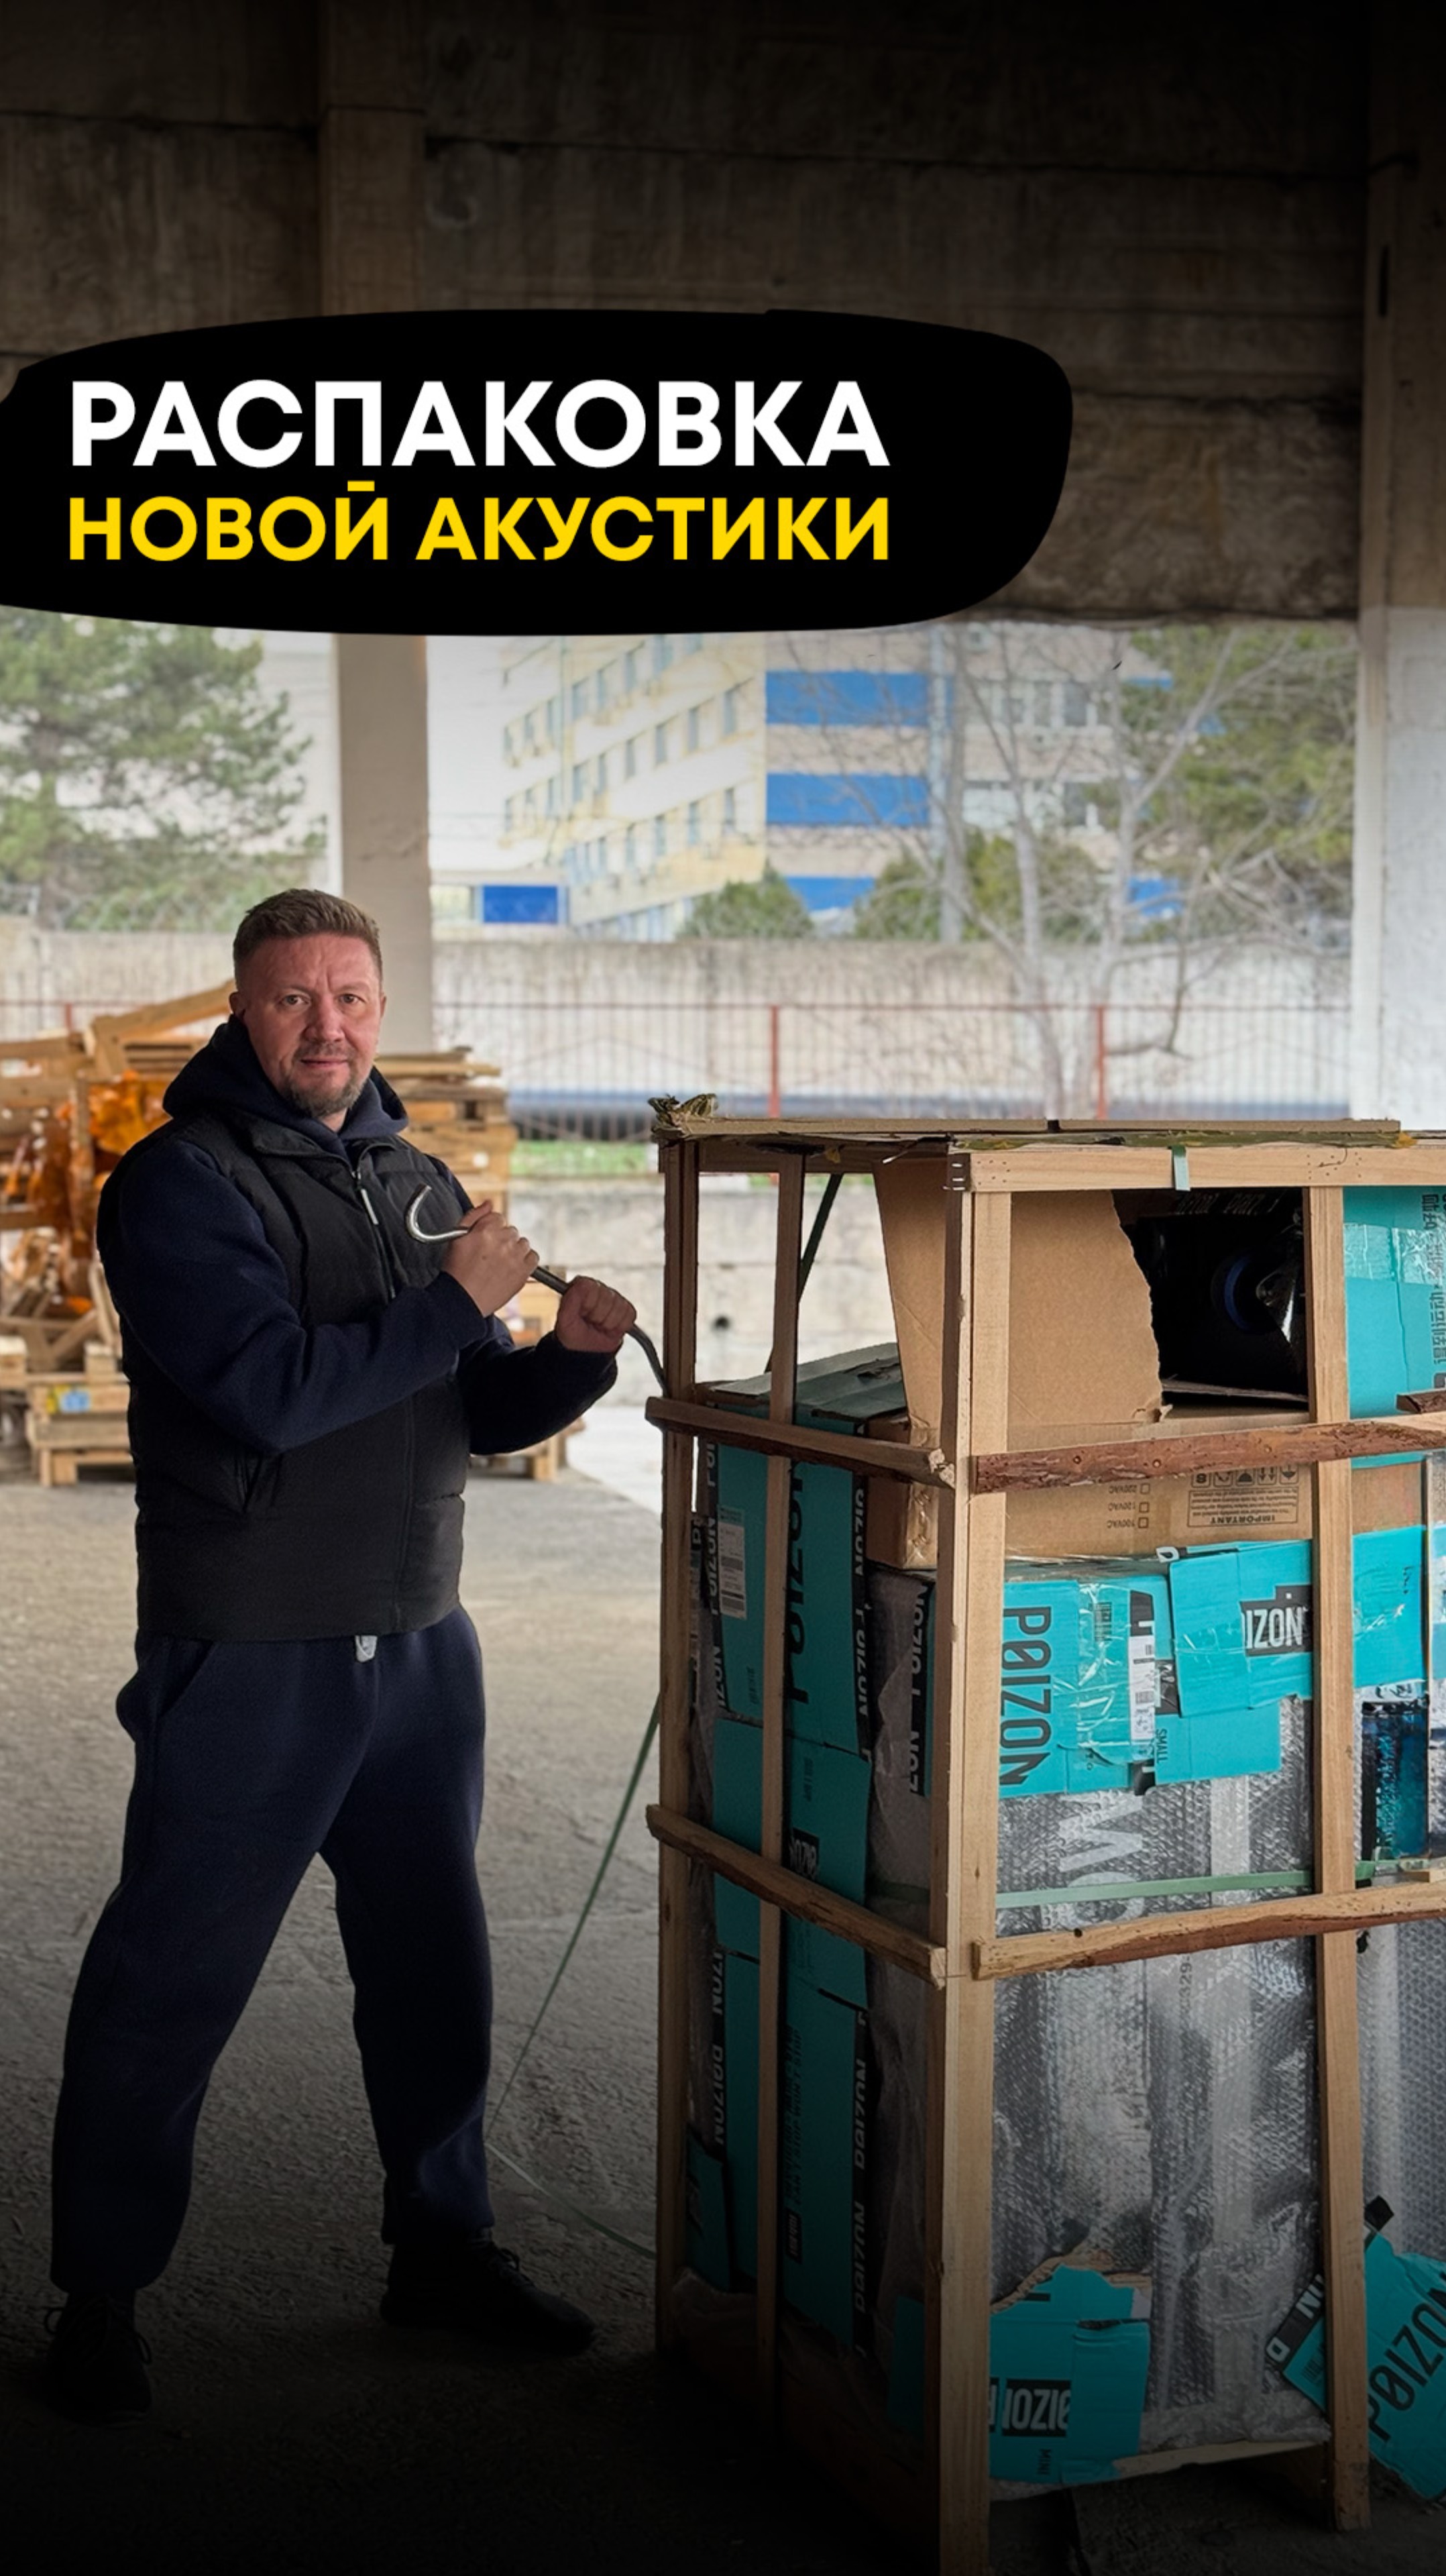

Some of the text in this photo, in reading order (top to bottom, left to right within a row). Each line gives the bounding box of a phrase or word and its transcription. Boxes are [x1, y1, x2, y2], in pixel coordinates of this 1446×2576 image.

[1209, 1514, 1276, 1524] IMPORTANT
[1241, 1606, 1303, 1650] IZON
[1156, 1728, 1168, 1764] SMALL
[1036, 2449, 1052, 2475] MINI
